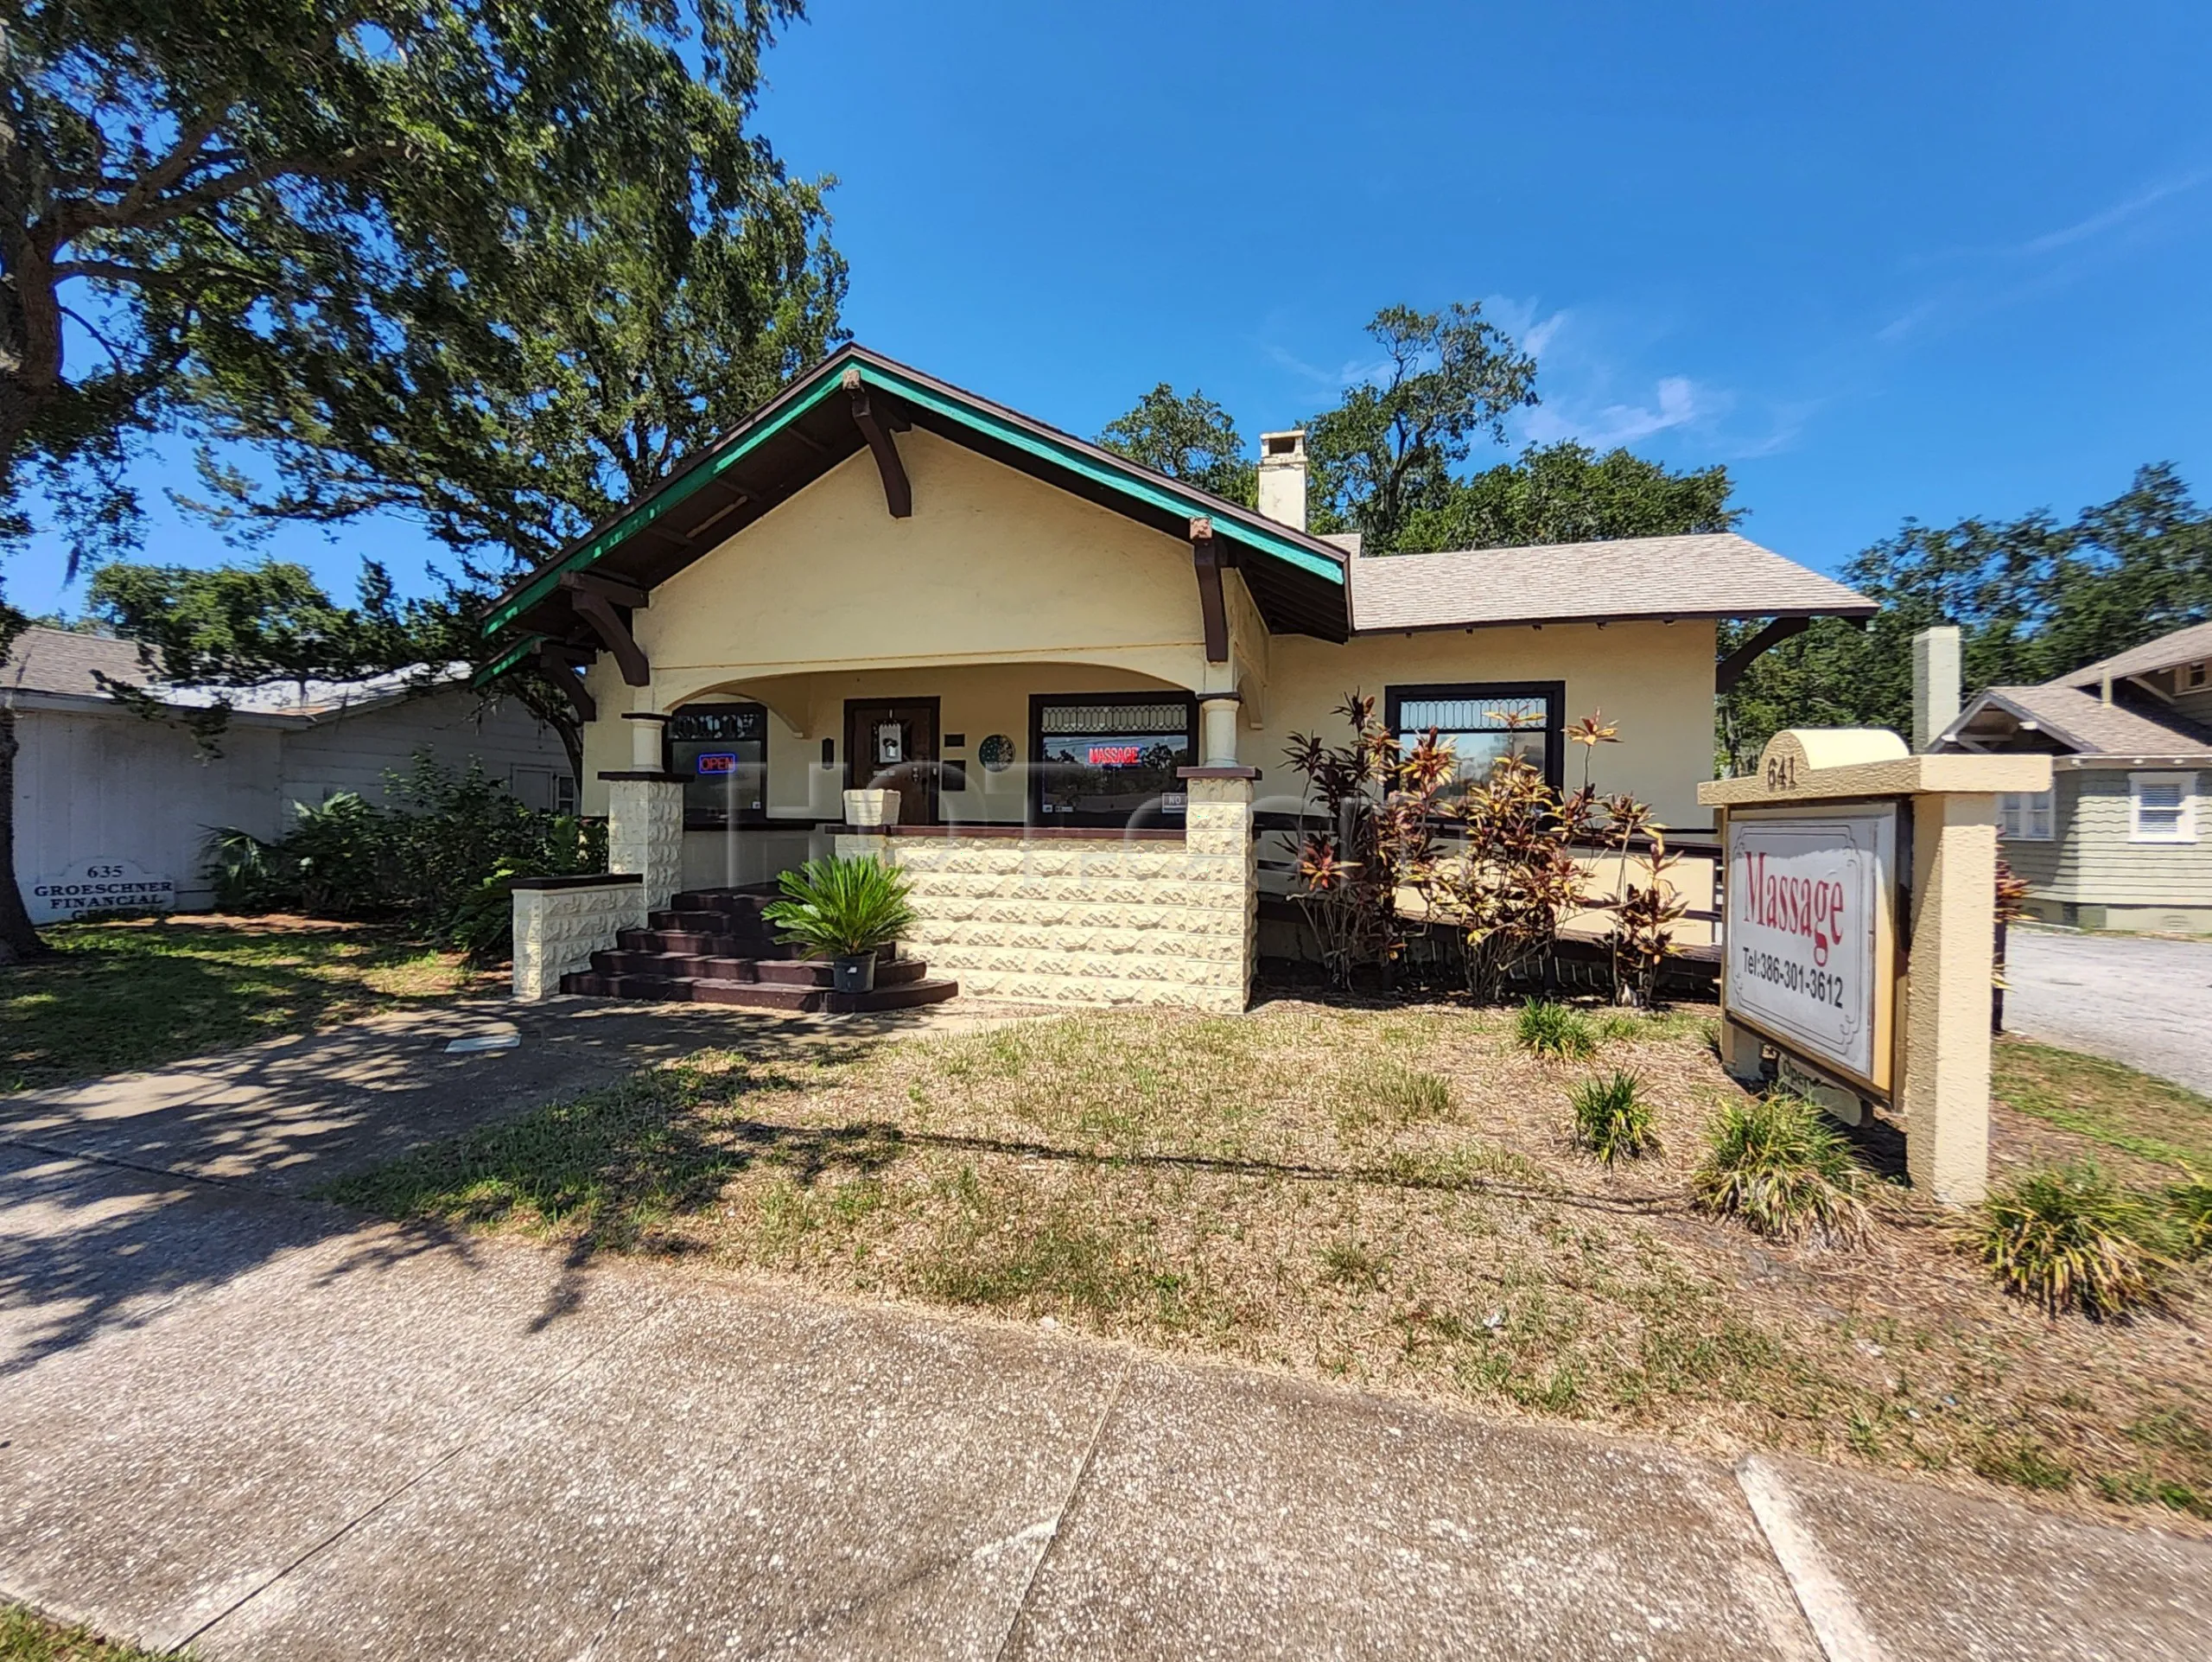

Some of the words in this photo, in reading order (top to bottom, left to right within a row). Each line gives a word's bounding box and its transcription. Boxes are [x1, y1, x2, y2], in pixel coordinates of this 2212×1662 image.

[1089, 746, 1140, 764] MASSAGE
[701, 757, 733, 770] OPEN
[1767, 756, 1797, 788] 641
[87, 865, 124, 878] 635
[34, 882, 173, 897] GROESCHNER
[50, 894, 164, 909] FINANCIAL
[1743, 850, 1844, 967] Massage
[1743, 946, 1843, 1009] Tel:386-301-3612
